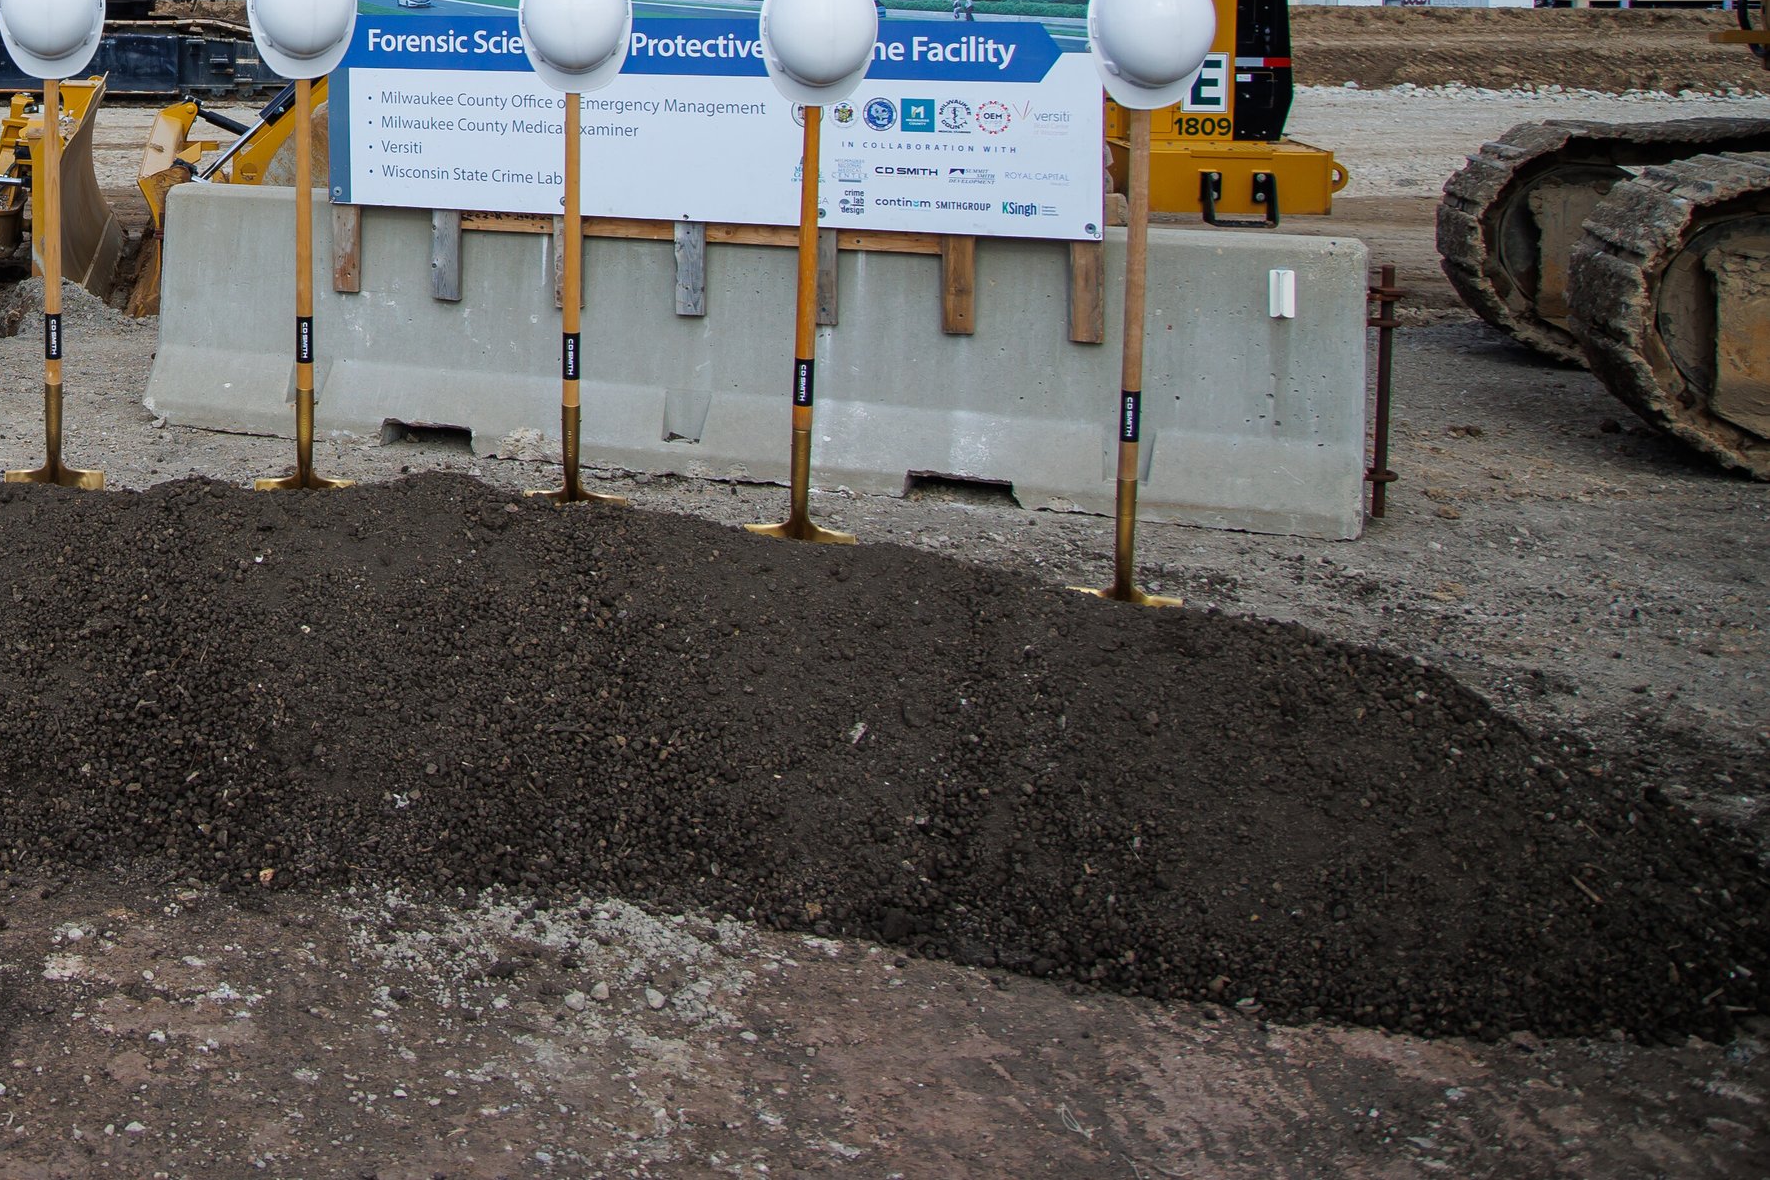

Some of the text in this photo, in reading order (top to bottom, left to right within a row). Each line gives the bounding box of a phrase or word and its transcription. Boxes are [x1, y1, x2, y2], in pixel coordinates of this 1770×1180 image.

[368, 28, 468, 53] Forensic
[473, 30, 527, 54] Scie
[631, 32, 764, 58] Protective
[912, 35, 1016, 70] Facility
[381, 91, 454, 106] Milwaukee
[457, 92, 507, 110] County
[511, 93, 553, 109] Office
[663, 98, 766, 118] Management
[939, 99, 972, 115] MILWAUKEE
[983, 112, 1003, 120] OEM
[1034, 111, 1070, 122] versiti
[381, 116, 454, 131] Milwaukee
[457, 117, 507, 135] County
[579, 123, 639, 137] xaminer
[940, 119, 968, 130] COUNTY
[1174, 117, 1232, 136] 1809
[382, 139, 423, 155] Versiti
[862, 141, 974, 152] COLLABORATION
[983, 146, 1017, 154] WITH
[382, 164, 563, 185] Wisconsin State Crime Lab
[875, 166, 938, 176] CD SMITH
[1005, 172, 1070, 181] ROYAL CAPITAL
[841, 206, 865, 215] design
[935, 201, 992, 212] SMITHGROUP
[1002, 202, 1037, 217] KSingh
